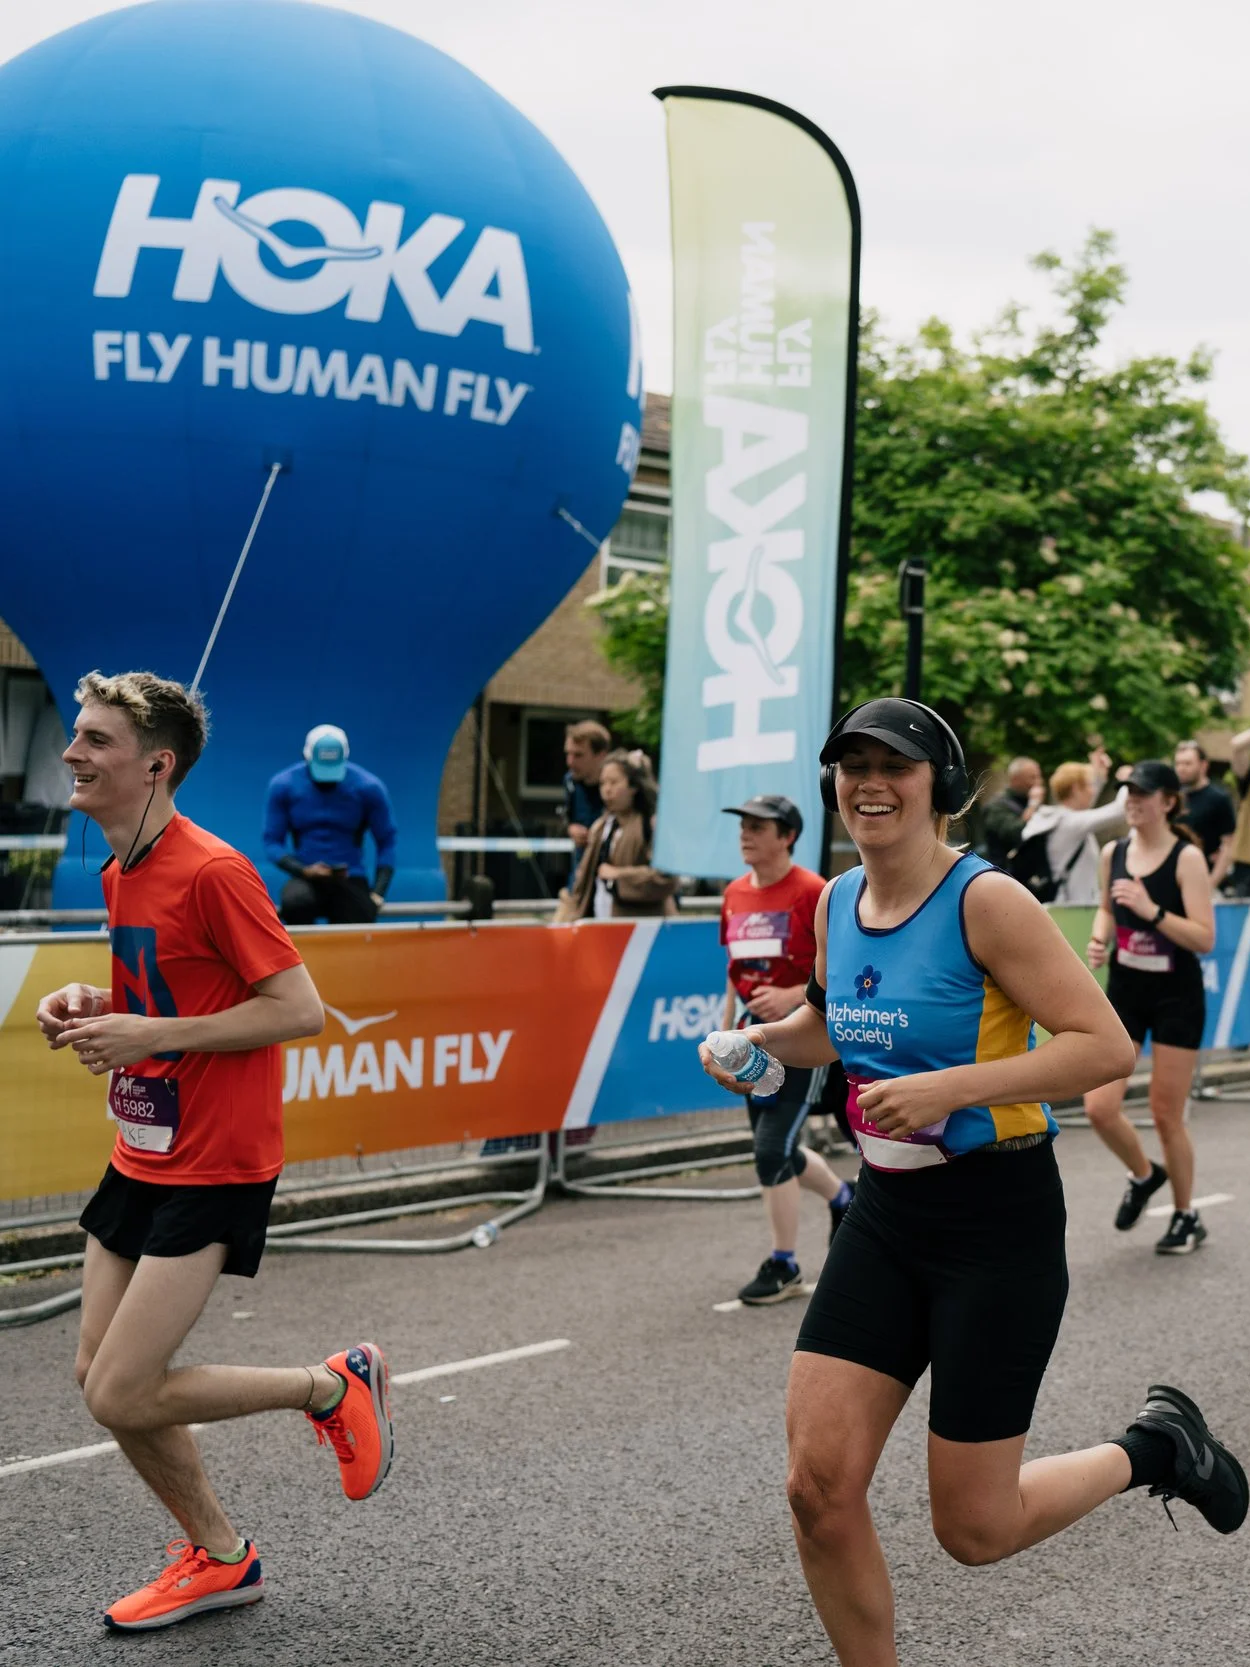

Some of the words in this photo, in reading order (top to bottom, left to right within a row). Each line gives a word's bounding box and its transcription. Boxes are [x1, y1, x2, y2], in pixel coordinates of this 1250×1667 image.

[93, 173, 535, 355] HOKA
[93, 330, 192, 383] FLY
[202, 336, 439, 412] HUMAN
[443, 368, 530, 426] FLY
[648, 993, 728, 1043] HOK
[826, 1002, 909, 1028] Alzheimer's
[834, 1022, 893, 1051] Society
[282, 1037, 425, 1104] UMAN
[433, 1029, 515, 1087] FLY
[114, 1095, 122, 1112] H
[122, 1098, 155, 1118] 5982
